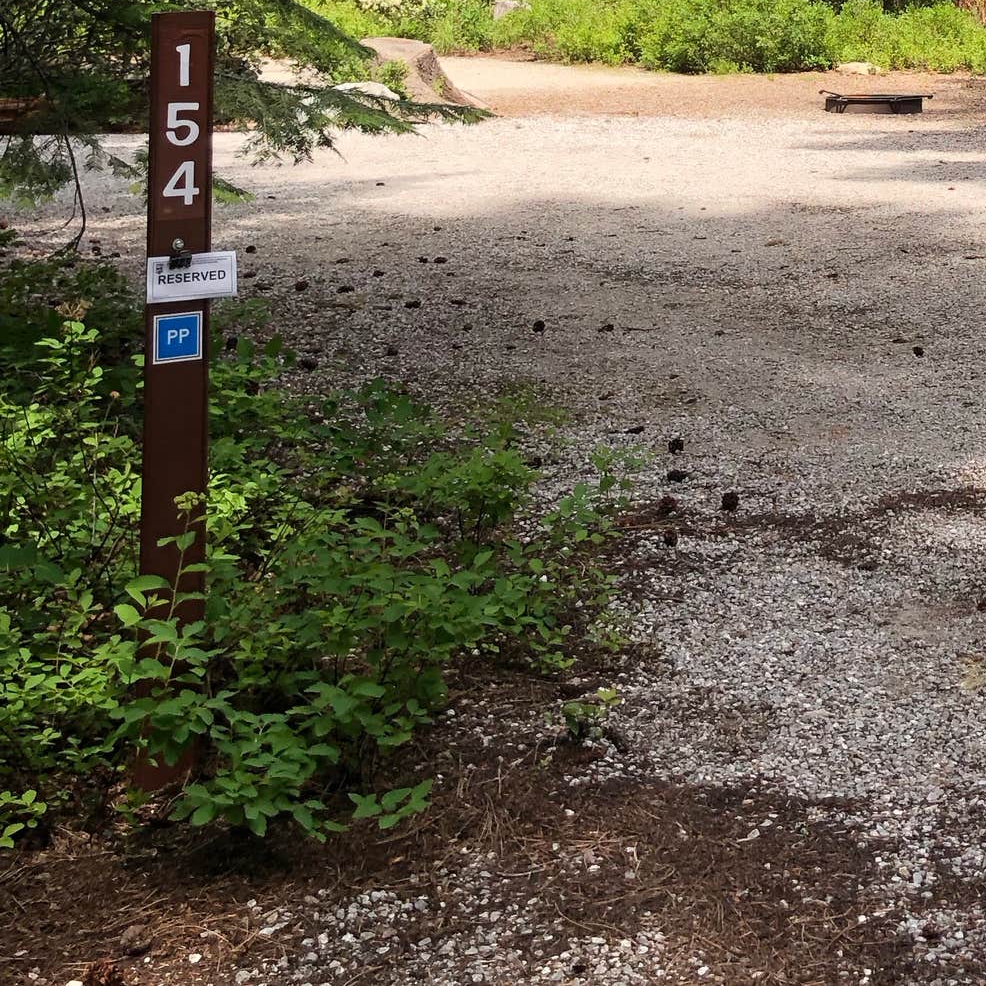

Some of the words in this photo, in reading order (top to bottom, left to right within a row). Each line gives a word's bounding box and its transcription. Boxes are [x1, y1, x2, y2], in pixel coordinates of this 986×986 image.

[162, 43, 200, 206] 154
[158, 270, 226, 285] RESERVED
[167, 328, 190, 345] PP
